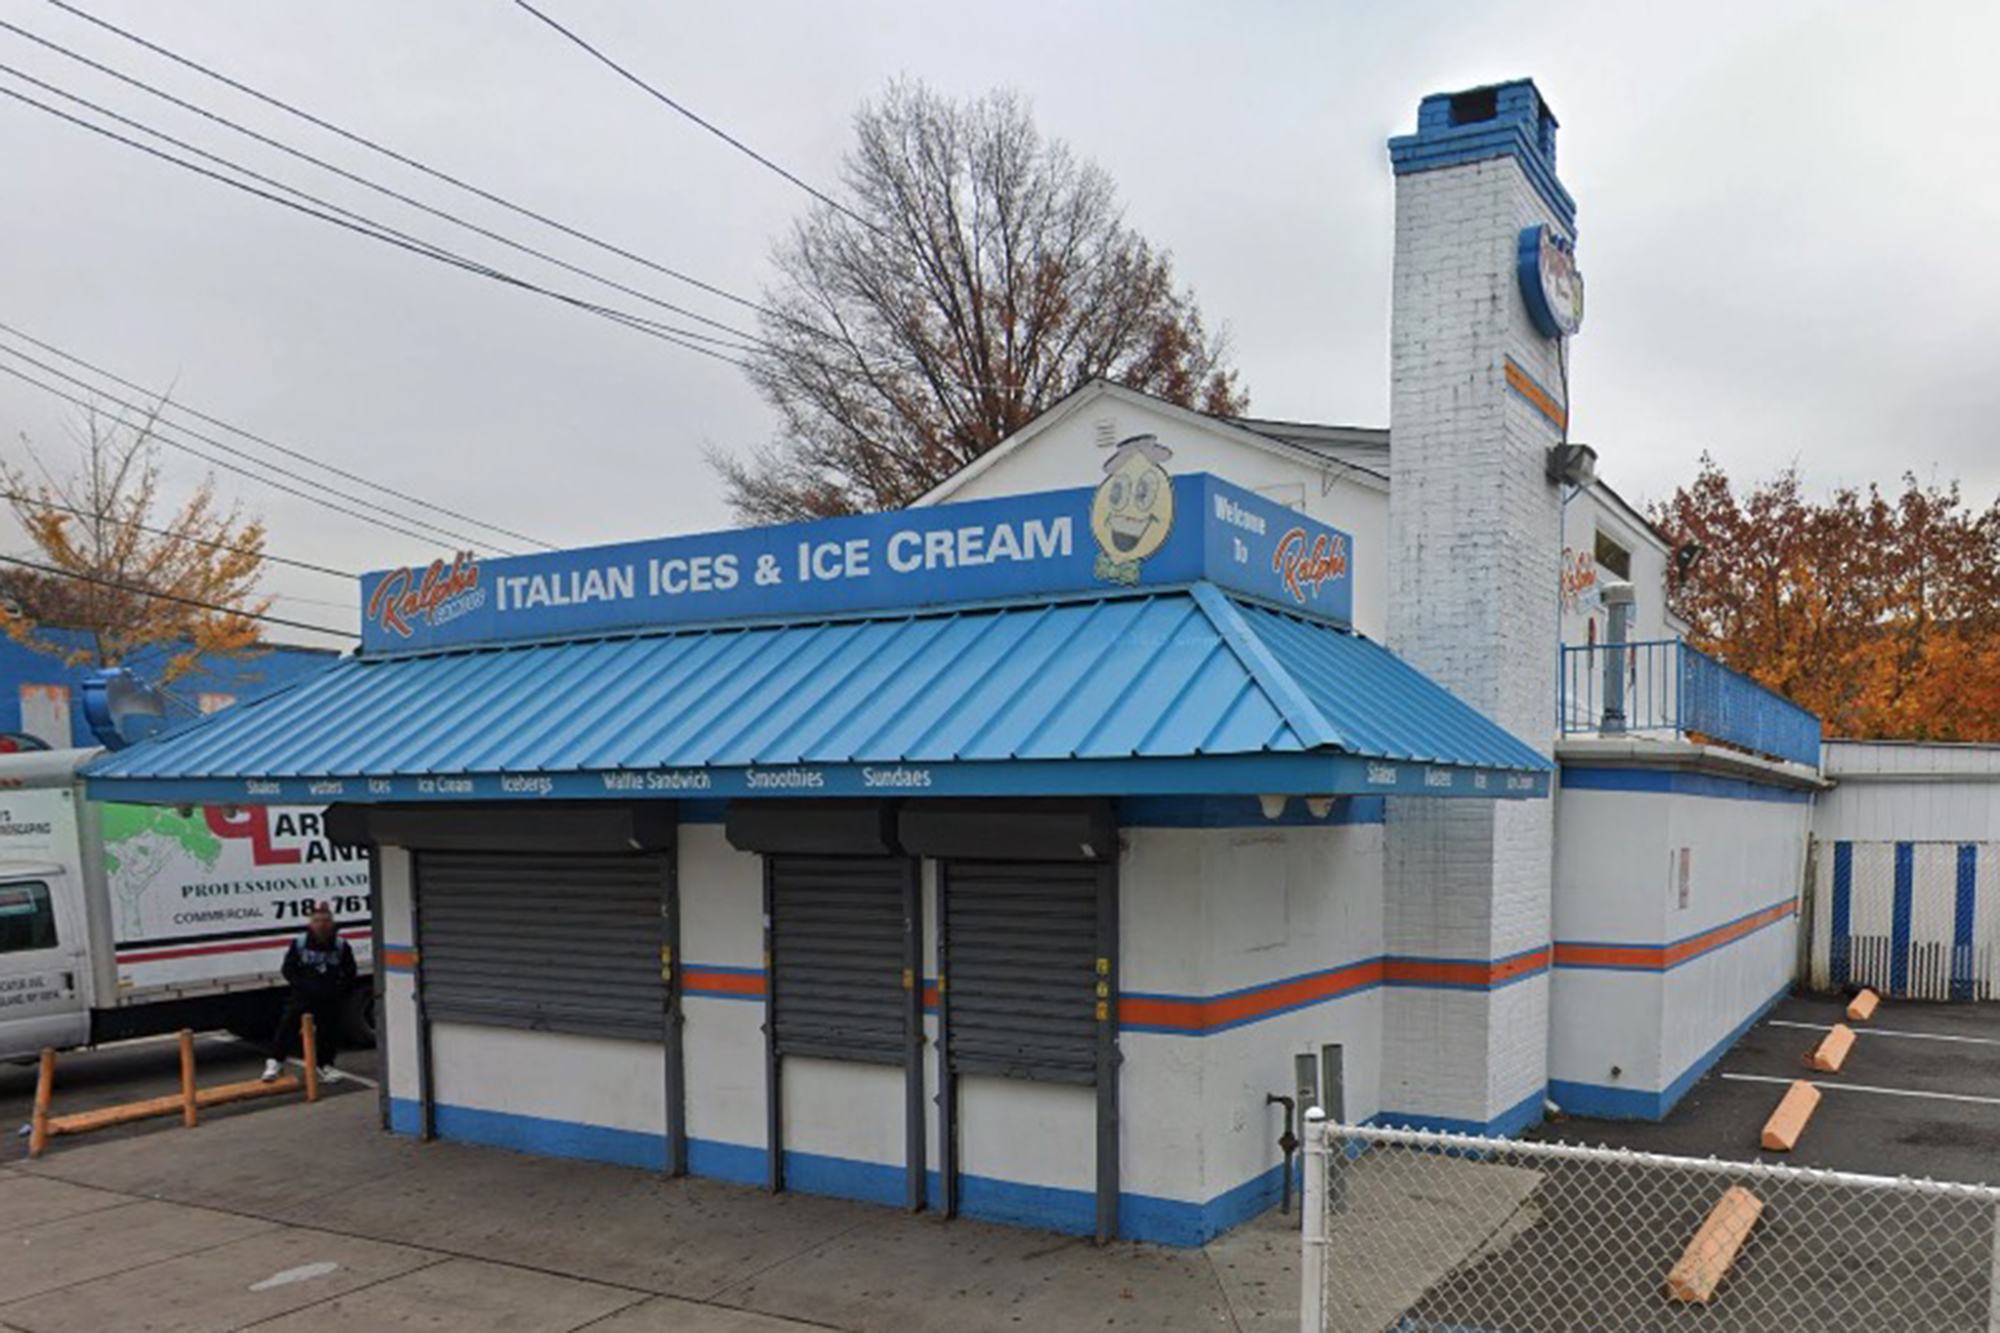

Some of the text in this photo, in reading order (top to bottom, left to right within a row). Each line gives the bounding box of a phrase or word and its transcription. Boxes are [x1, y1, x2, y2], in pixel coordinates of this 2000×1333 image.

[1213, 493, 1266, 536] Welcome
[495, 516, 1074, 611] ITALIAN ICES & ICE CREAM
[1233, 537, 1248, 564] To
[501, 774, 553, 796] Icebergs
[646, 768, 712, 790] Sandwich
[745, 766, 824, 789] Smoothies
[862, 766, 932, 788] Sundaes
[181, 876, 317, 899] PROFESSIONAL
[173, 907, 264, 925] COMMERCIAL
